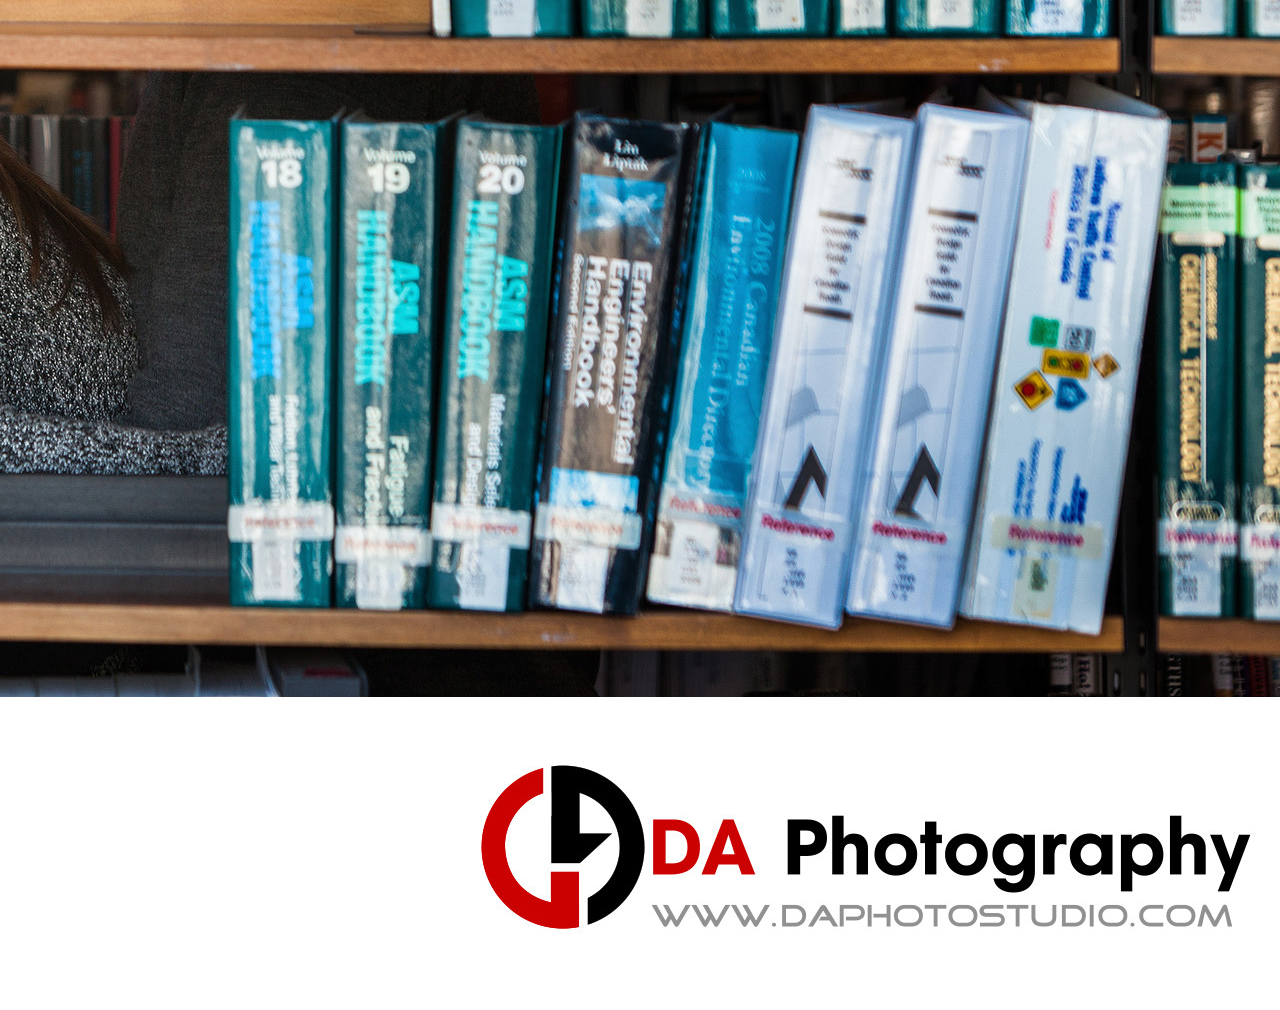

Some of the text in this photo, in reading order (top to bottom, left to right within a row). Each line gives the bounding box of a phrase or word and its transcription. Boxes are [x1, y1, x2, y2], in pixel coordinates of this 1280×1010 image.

[261, 160, 304, 189] 18
[367, 163, 411, 194] 19
[478, 165, 525, 195] 20
[354, 210, 388, 386] HANDBOOK
[388, 259, 420, 334] ASM
[456, 200, 500, 382] HANDBOOK
[575, 255, 609, 408] Handbook
[597, 258, 632, 415] Engineers'
[736, 280, 768, 388] Canadian
[615, 260, 654, 465] Environmental
[1179, 254, 1201, 483] CHEMICAL TECHNOLOGY
[384, 435, 410, 518] Fatigue
[486, 393, 506, 470] Materials
[762, 513, 835, 541] Reference
